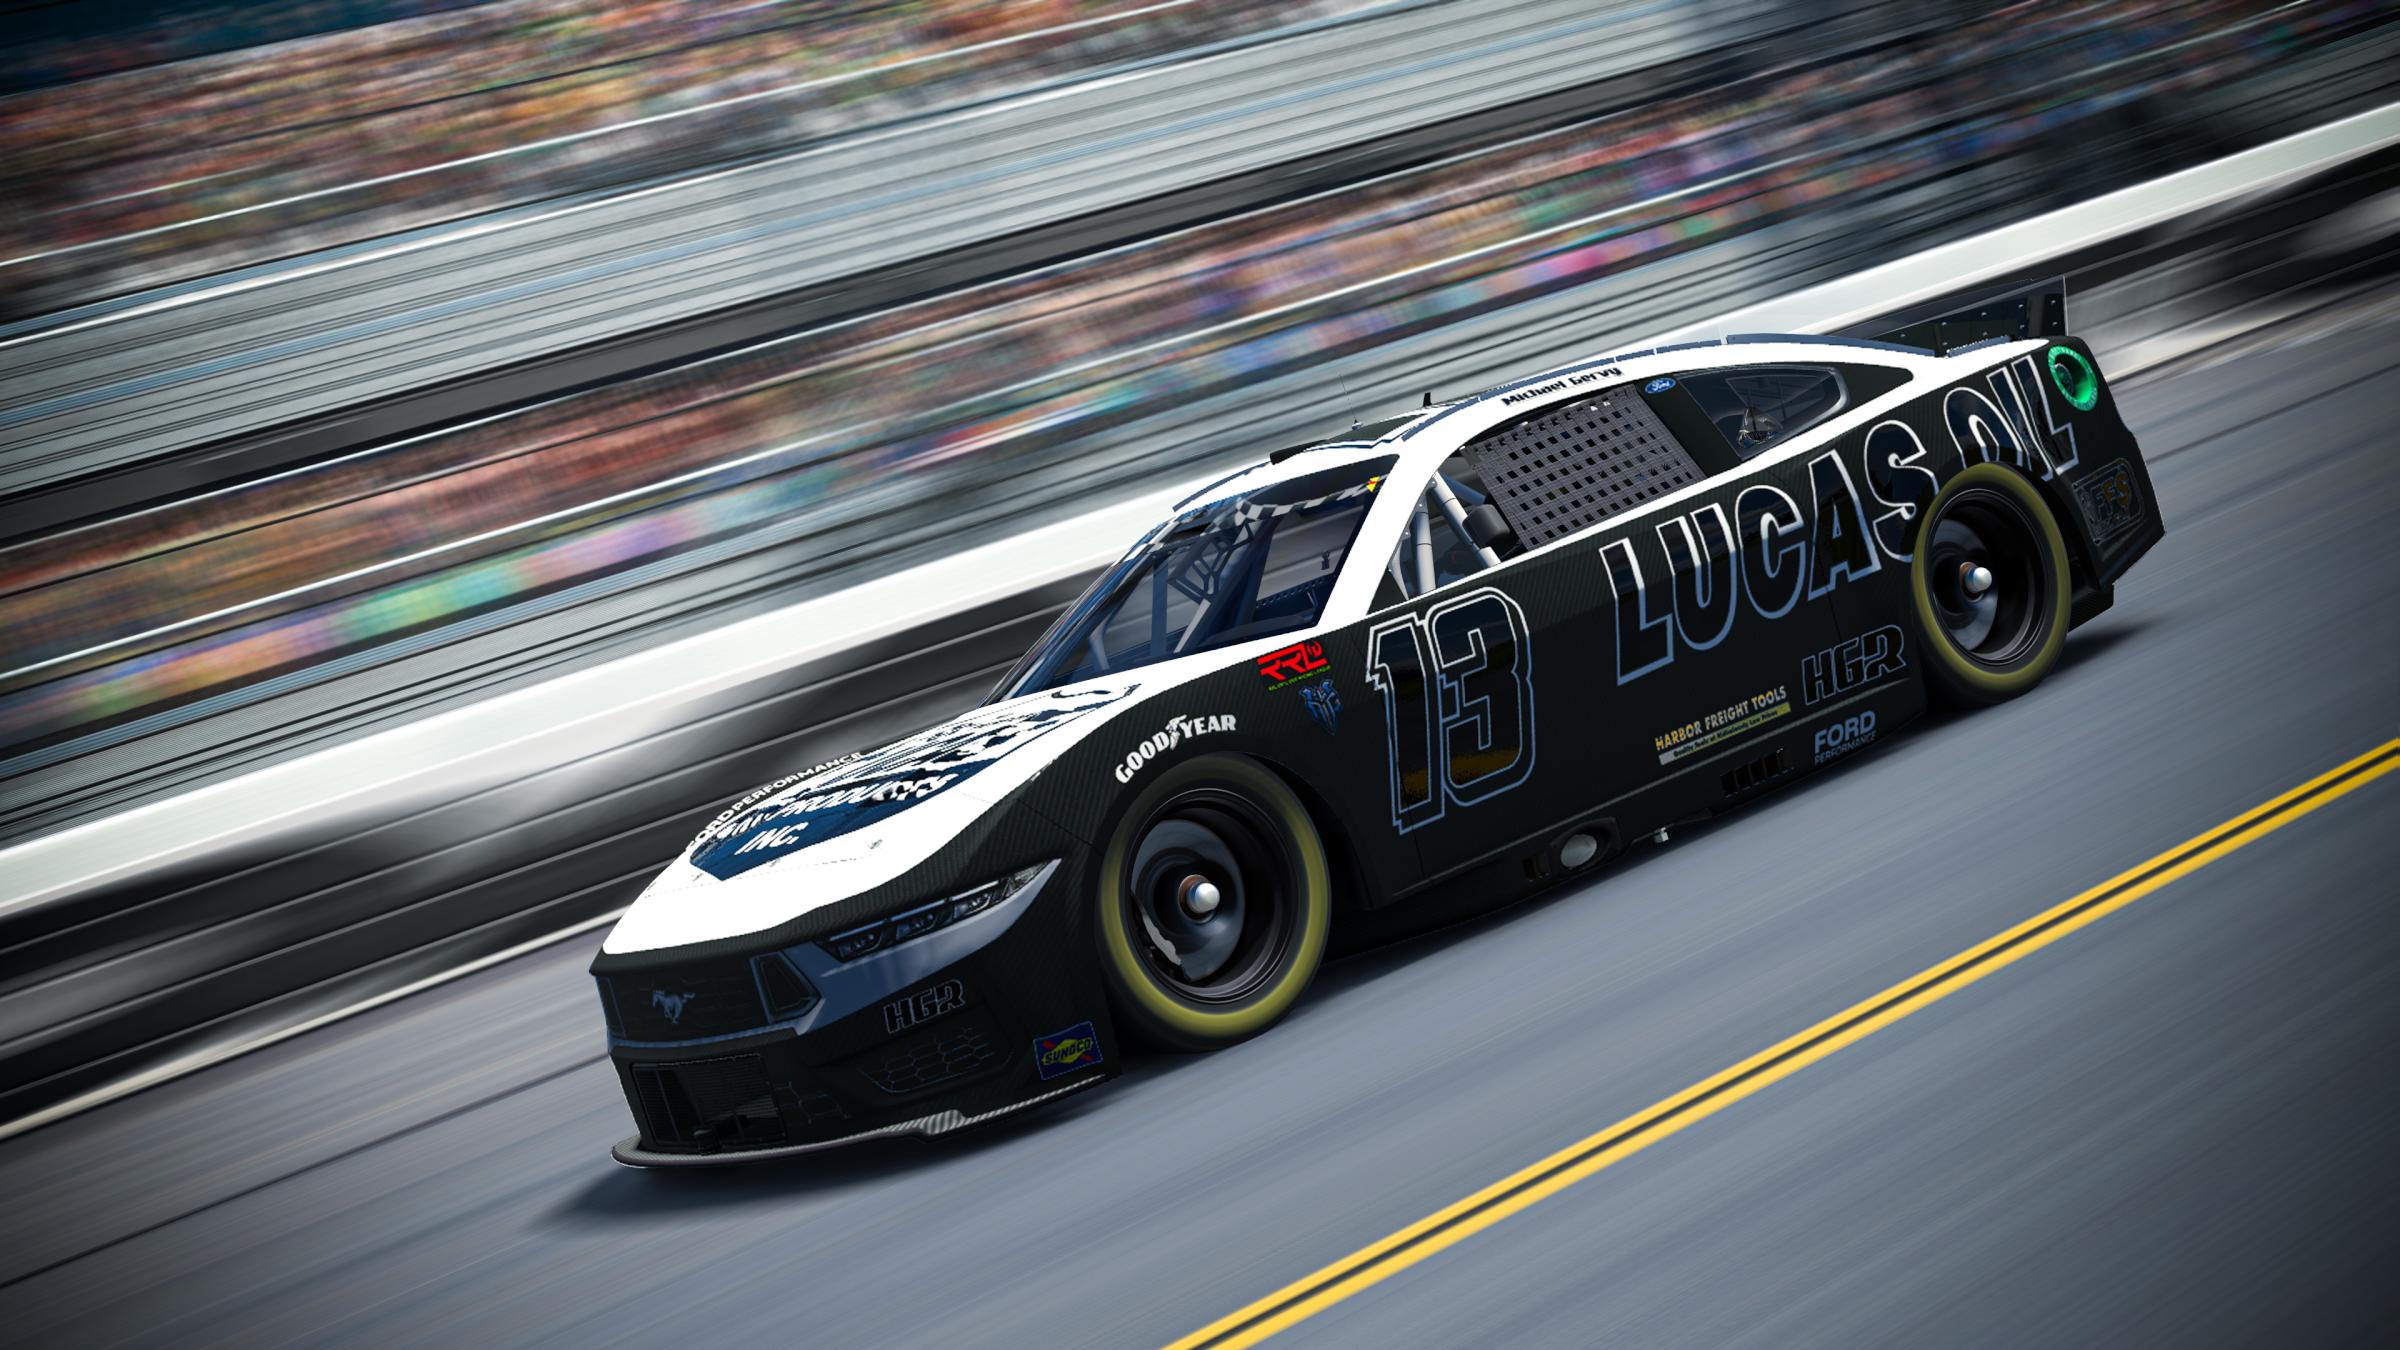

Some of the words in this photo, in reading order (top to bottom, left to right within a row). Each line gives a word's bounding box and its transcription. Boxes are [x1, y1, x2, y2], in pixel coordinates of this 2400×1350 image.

[1501, 381, 1566, 406] Michael
[1599, 420, 1940, 685] LUCAS
[1801, 624, 1907, 705] HGR
[1366, 587, 1536, 835] 13
[1654, 720, 1703, 751] HARBOR
[1704, 700, 1749, 730] FREIGHT
[1751, 685, 1787, 711] TOOLS
[1814, 710, 1876, 754] FORD
[731, 752, 863, 811] PERFORMANCE
[883, 979, 966, 1034] HGR
[1043, 1036, 1092, 1065] SUNOCO
